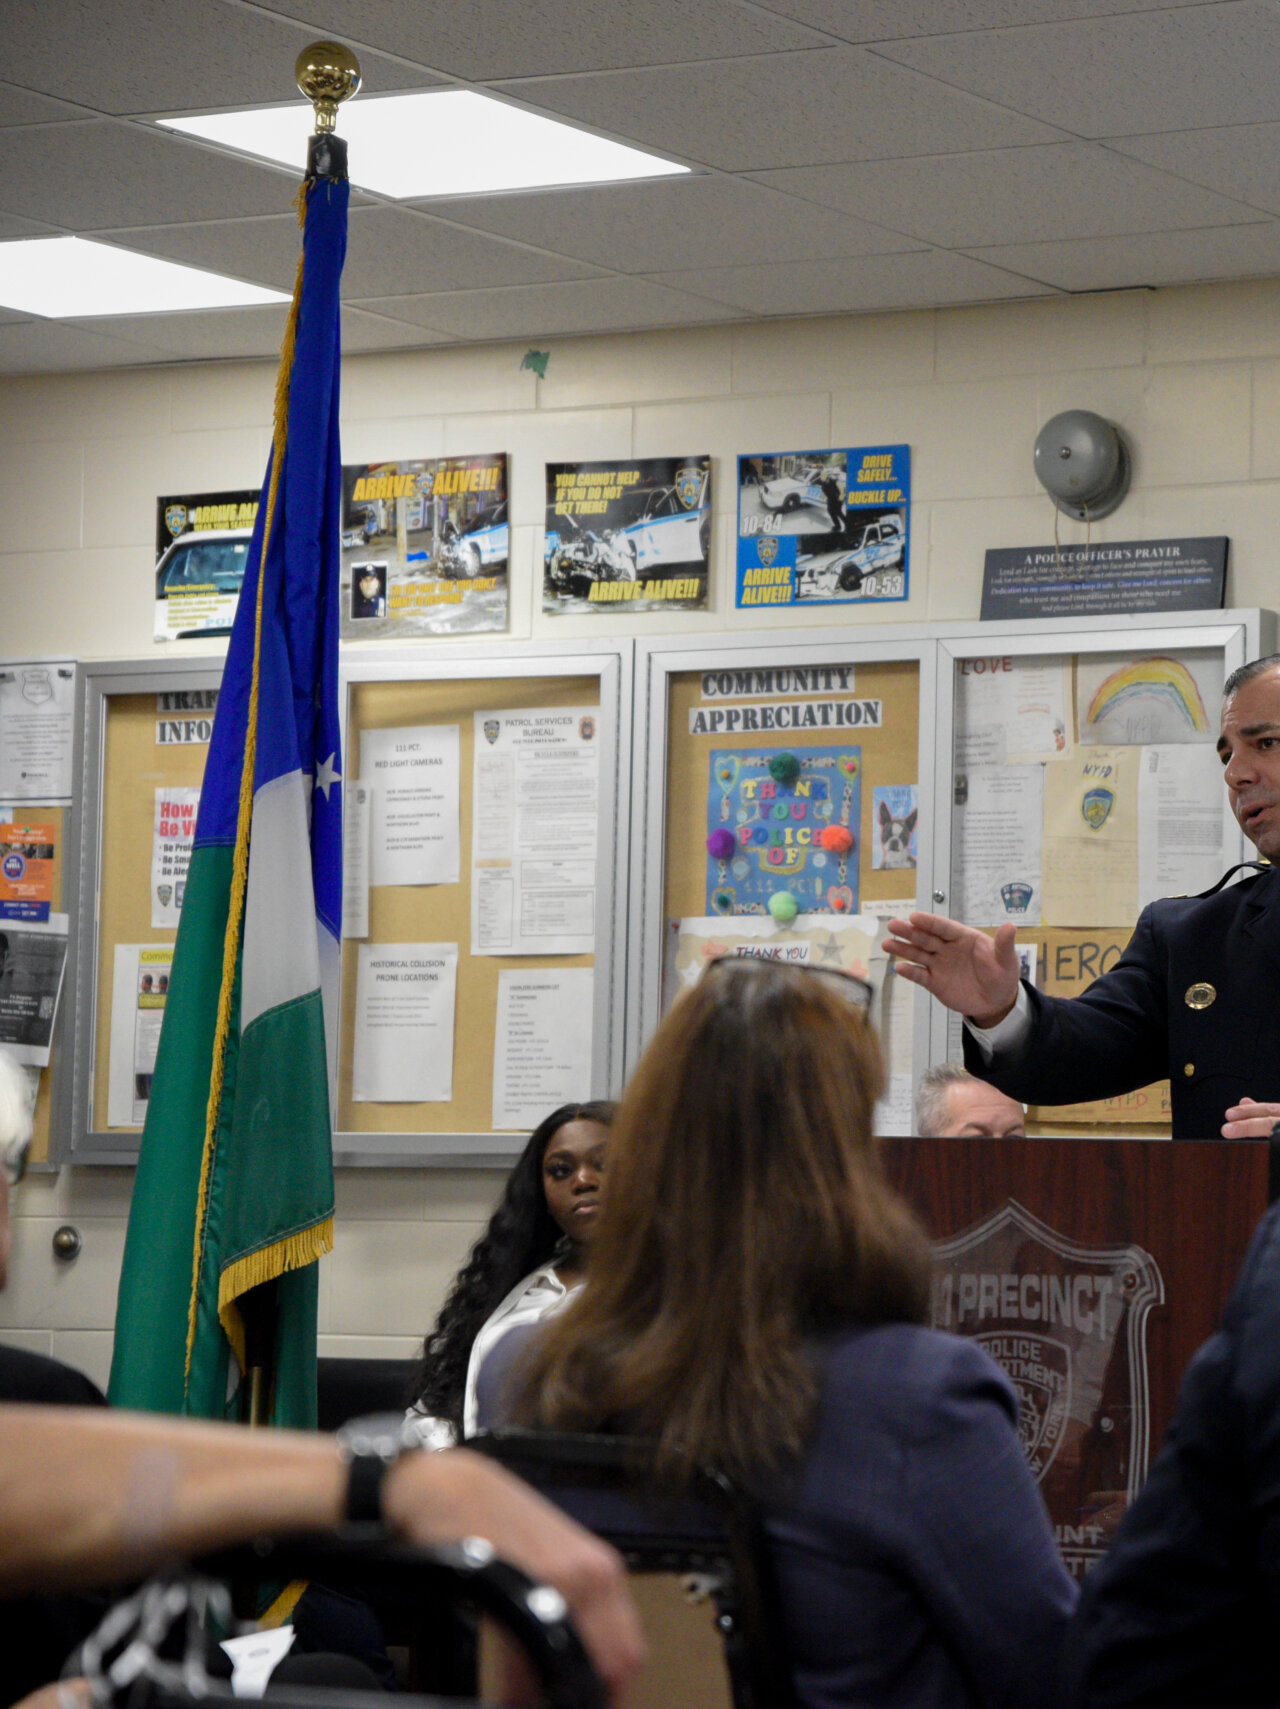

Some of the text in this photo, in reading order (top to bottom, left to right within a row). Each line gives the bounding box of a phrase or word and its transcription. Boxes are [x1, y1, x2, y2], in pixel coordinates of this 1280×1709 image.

[862, 454, 893, 469] DRIVE
[353, 467, 499, 501] ARRIVE ALIVE!!!
[555, 471, 640, 488] YOU CANNOT HELP
[555, 486, 623, 501] IF YOU DO NOT
[847, 490, 886, 505] BUCKLE
[555, 500, 609, 516] GET THERE!
[743, 514, 783, 534] 10-84
[1025, 555, 1032, 565] A
[1034, 552, 1073, 564] POLICE
[1134, 546, 1181, 558] PRAYER
[743, 567, 792, 586] ARRIVE
[588, 578, 700, 601] ARRIVE ALIVE!!!
[741, 585, 793, 605] ALIVE!!!
[860, 576, 902, 596] 10-53
[961, 657, 1013, 676] LOVE
[702, 667, 852, 697] COMMUNITY
[505, 717, 573, 727] PATROL SERVICES
[692, 701, 880, 734] APPRECIATION
[159, 720, 212, 743] INFO
[375, 757, 443, 769] RED LIGHT CAMERAS
[743, 780, 829, 800] THANK
[160, 802, 194, 818] How
[758, 802, 807, 820] YOU
[160, 820, 179, 837] Be
[739, 827, 826, 846] POLICE
[767, 847, 798, 865] OF
[736, 946, 809, 960] THANK YOU
[370, 959, 446, 969] HISTORICAL COLLISION
[376, 973, 439, 982] PRONE LOCATIONS
[958, 1274, 1112, 1341] PRECINCT
